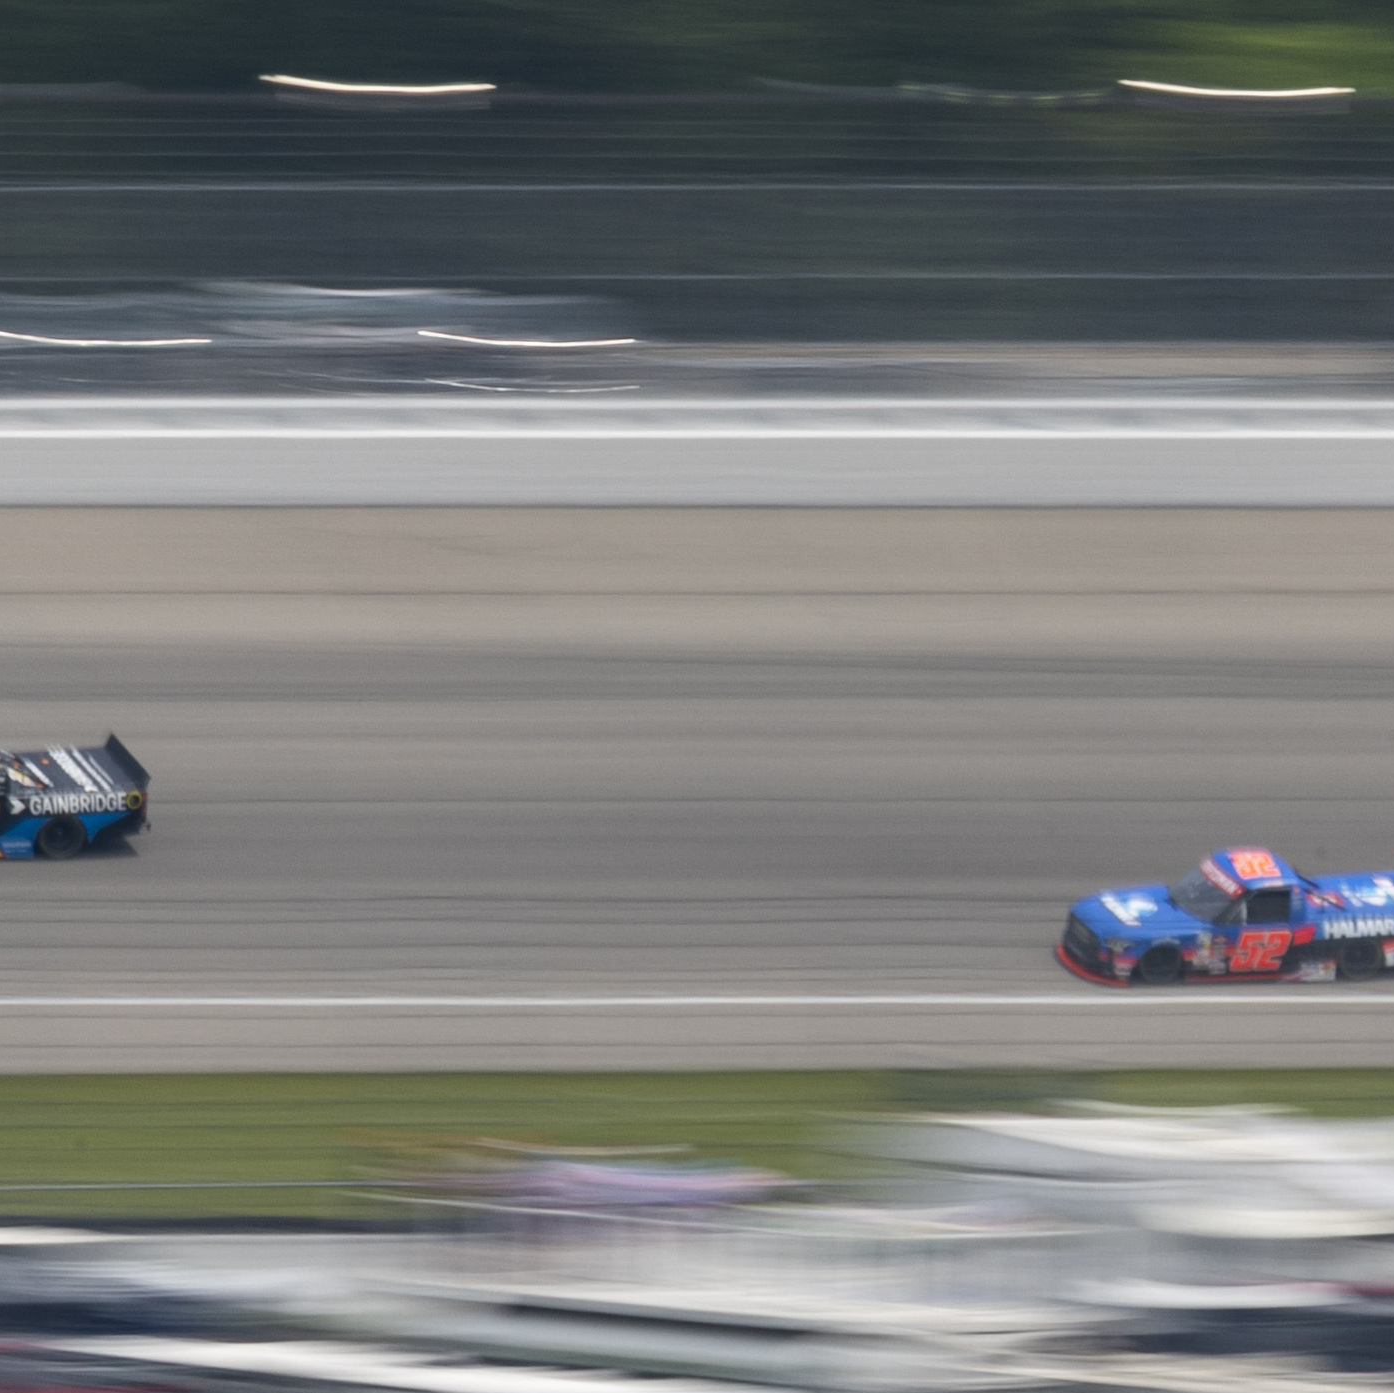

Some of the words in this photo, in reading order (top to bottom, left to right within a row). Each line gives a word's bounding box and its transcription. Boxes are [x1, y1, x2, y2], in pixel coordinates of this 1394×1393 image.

[29, 791, 128, 816] GAINBRIDGE
[1231, 851, 1283, 880] 52
[1229, 931, 1293, 973] 52
